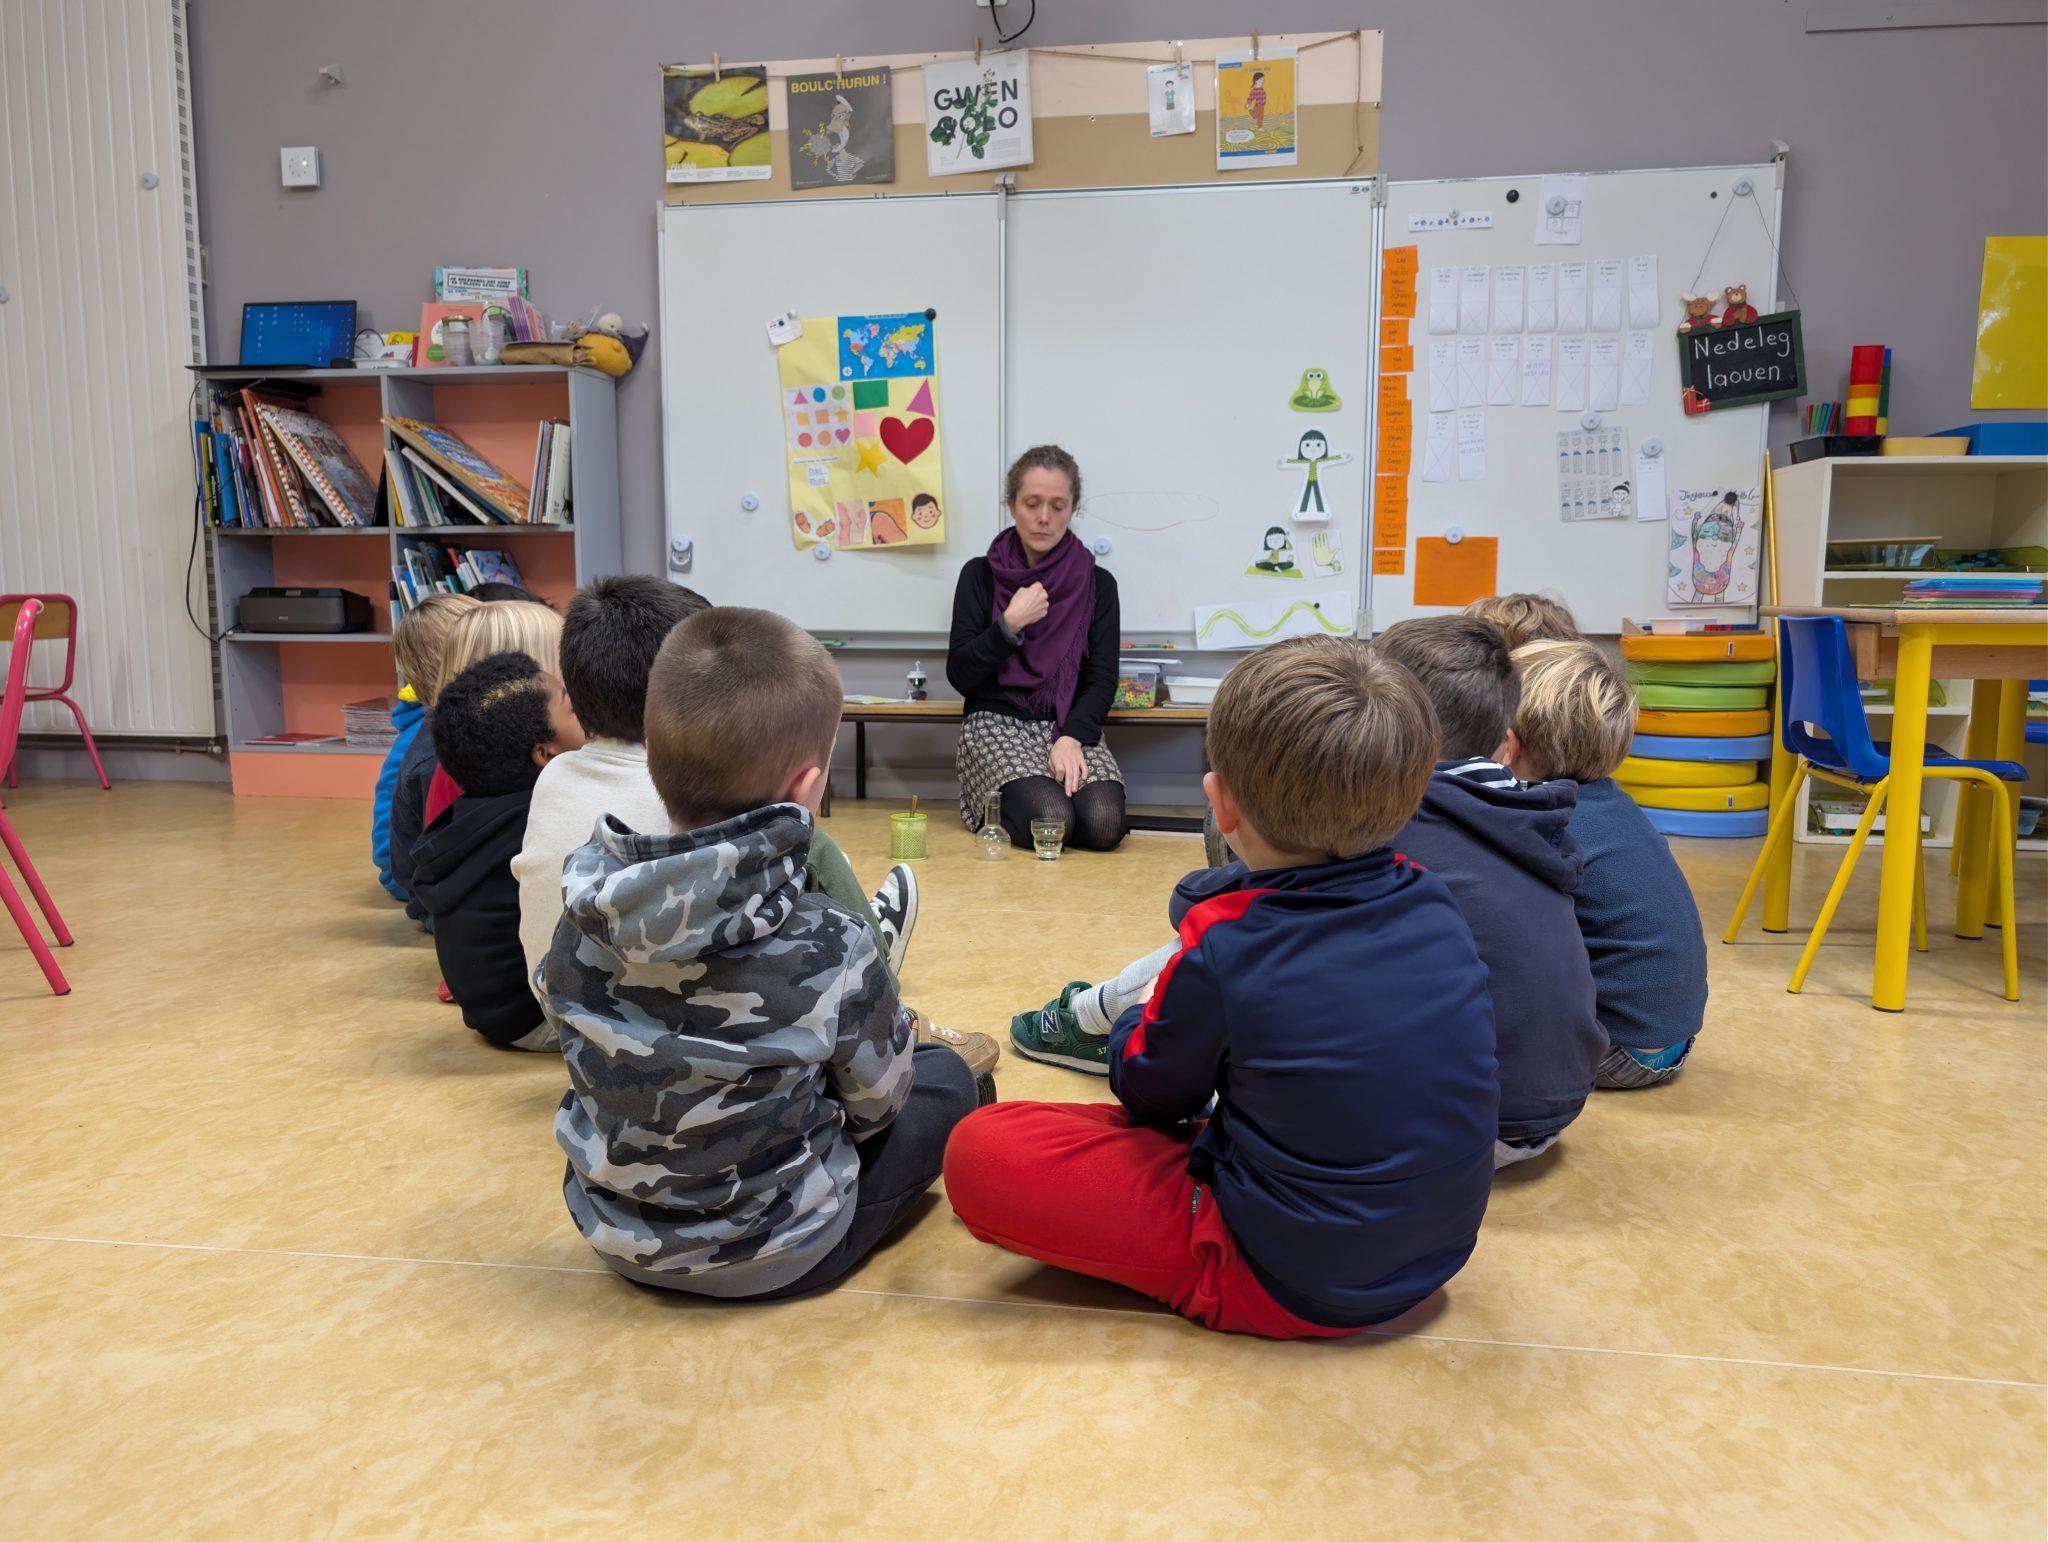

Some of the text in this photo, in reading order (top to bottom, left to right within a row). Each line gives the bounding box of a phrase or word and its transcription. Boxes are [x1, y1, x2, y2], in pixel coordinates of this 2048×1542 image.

[791, 75, 880, 93] BOULC'HURUN
[933, 78, 1018, 111] GWEN
[1694, 326, 1790, 359] Nedeleg
[1707, 364, 1780, 389] laouen
[1041, 1010, 1059, 1034] N
[1096, 1046, 1109, 1055] 37
